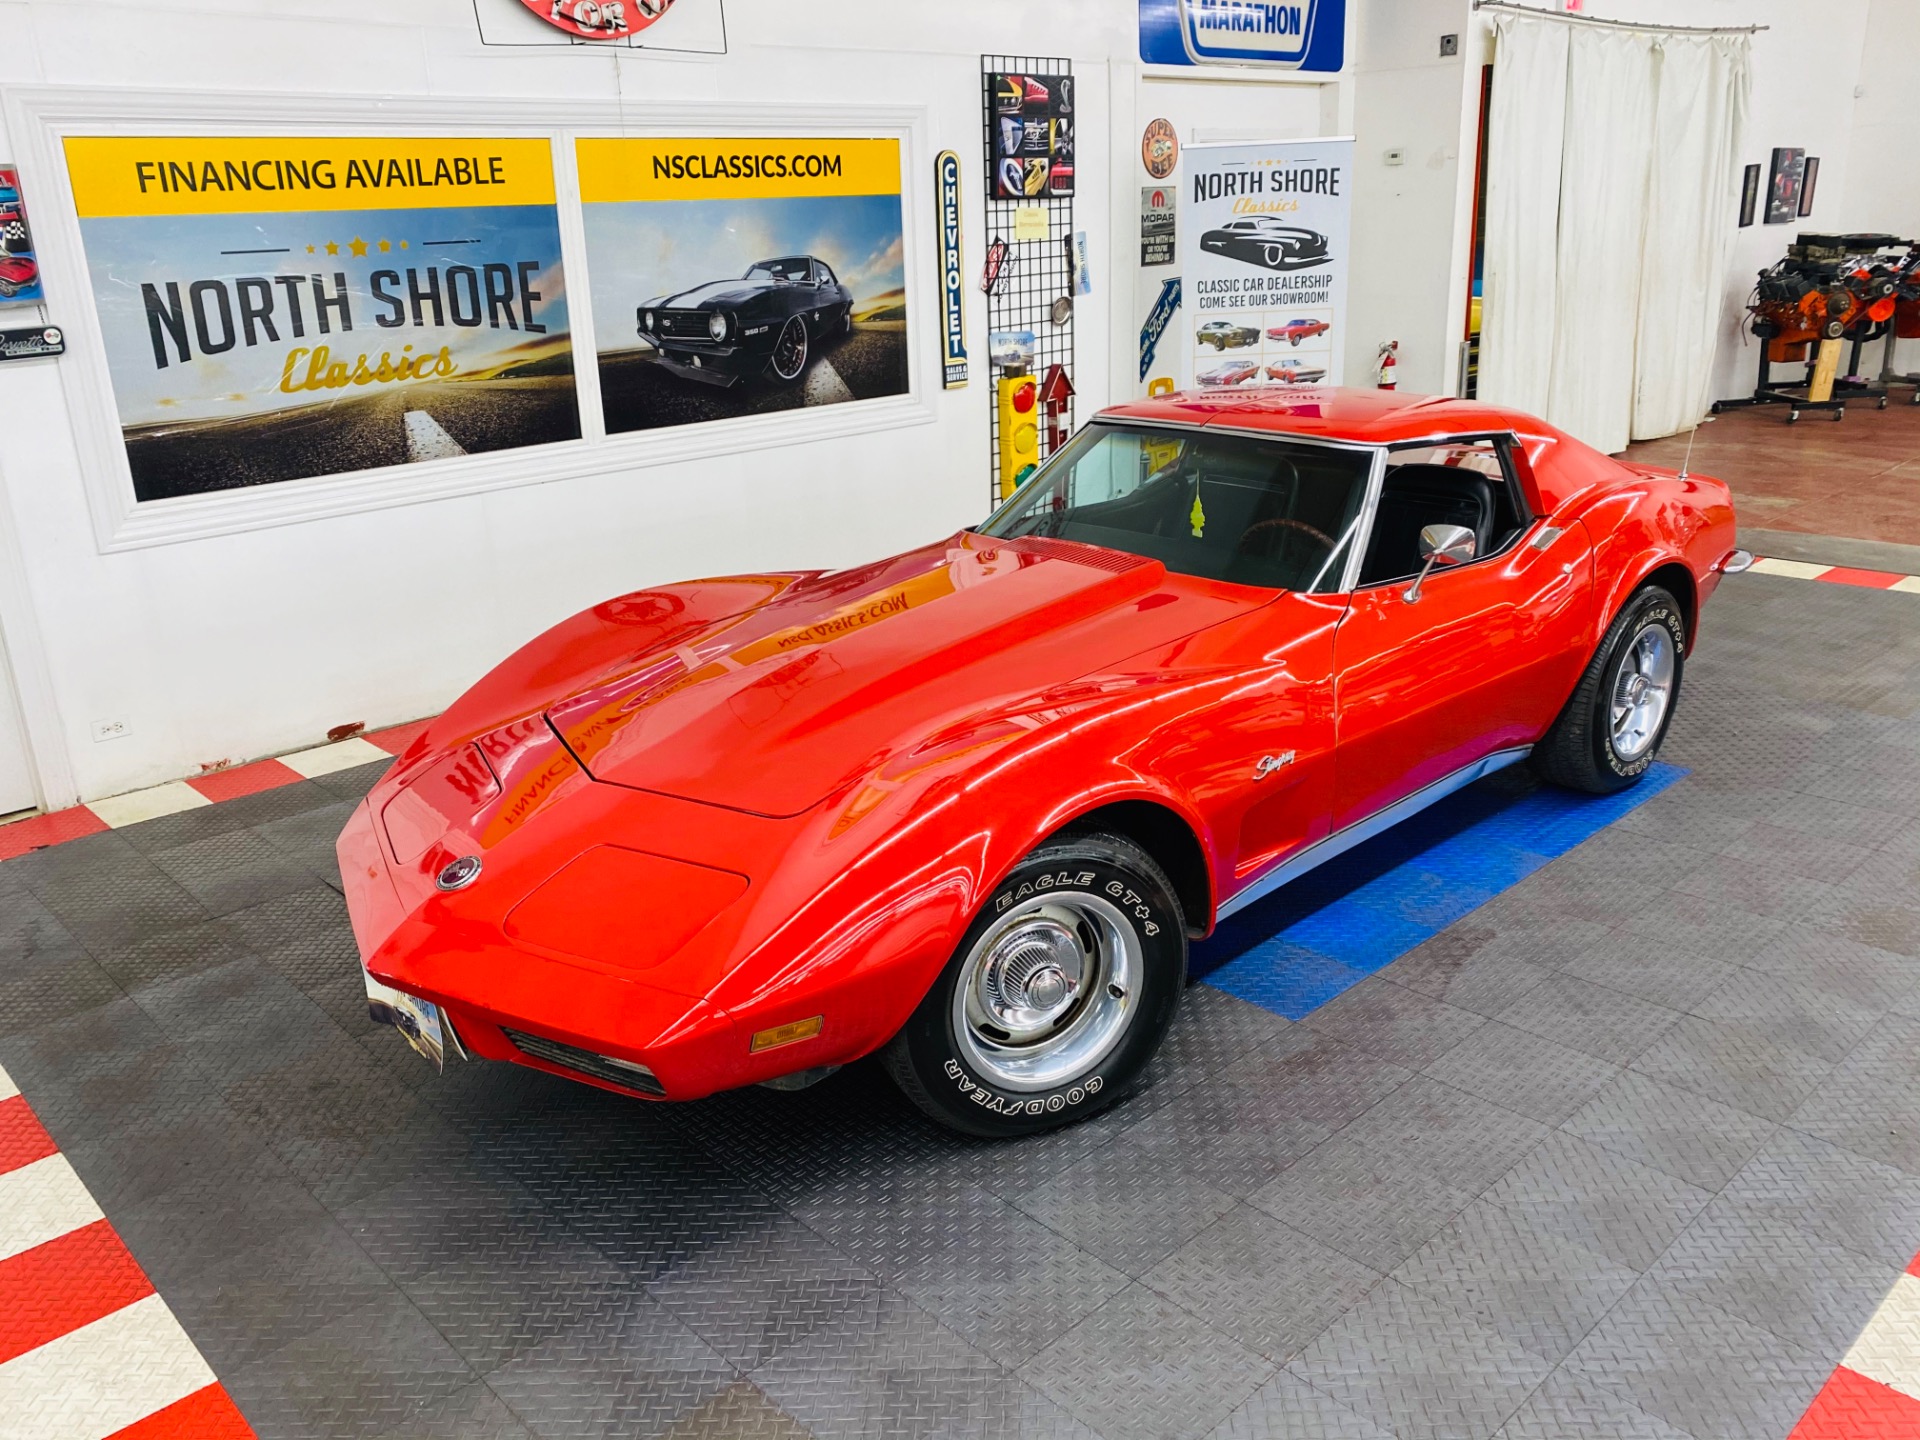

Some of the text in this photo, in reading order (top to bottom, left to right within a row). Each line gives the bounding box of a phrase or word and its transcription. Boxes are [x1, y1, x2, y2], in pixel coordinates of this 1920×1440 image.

[1200, 0, 1301, 35] MARATHON
[1145, 120, 1174, 152] SUPER
[135, 156, 505, 193] FINANCING AVAILABLE
[653, 155, 842, 179] NSCLASSICS.COM
[1151, 154, 1174, 176] BEE
[1194, 167, 1340, 203] NORTH SHORE
[1141, 213, 1175, 223] MOPAR
[1232, 197, 1299, 214] Classics
[944, 162, 961, 354] CHEVROLET
[1197, 273, 1333, 294] CLASSIC CAR DEALERSHIP
[1199, 291, 1329, 309] COME SEE OUR SHOWROOM!
[140, 260, 547, 370] NORTH SHORE
[1148, 299, 1172, 342] Ford
[280, 344, 458, 394] Classics
[996, 871, 1160, 937] EAGLE GT+4
[944, 1058, 1103, 1115] GOODYEAR
